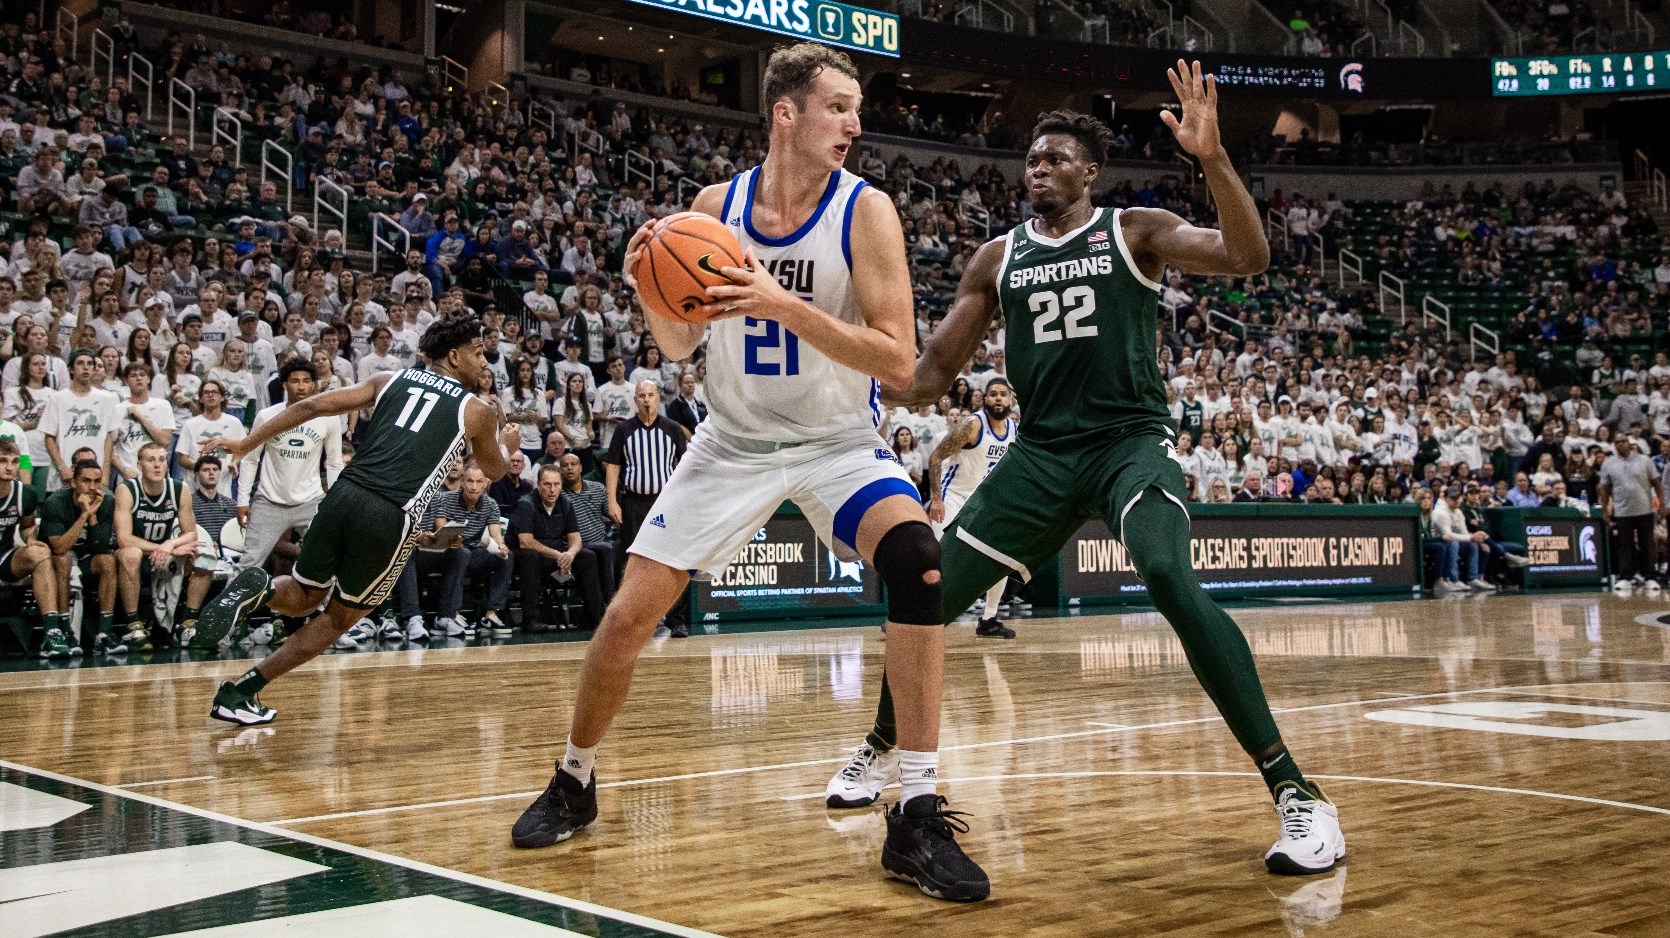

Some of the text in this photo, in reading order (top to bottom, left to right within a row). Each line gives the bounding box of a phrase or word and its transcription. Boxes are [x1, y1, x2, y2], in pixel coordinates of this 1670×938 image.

[660, 0, 898, 51] SARS SPO
[1569, 58, 1592, 74] FT%
[1602, 58, 1612, 73] R
[1623, 56, 1633, 71] A
[744, 259, 815, 293] VSU
[1009, 255, 1113, 289] SPARTANS
[1028, 285, 1099, 344] 22
[744, 316, 799, 376] 21
[403, 369, 463, 398] HOGGARD
[395, 387, 441, 433] 11
[305, 428, 321, 444] STATE
[143, 523, 167, 541] 10
[731, 543, 803, 564] RTSBOOK
[1078, 537, 1403, 572] DOWNL CAESARS SPORTSBOOK & CASINO APP
[726, 565, 778, 586] CASINO
[758, 588, 780, 596] BETTING
